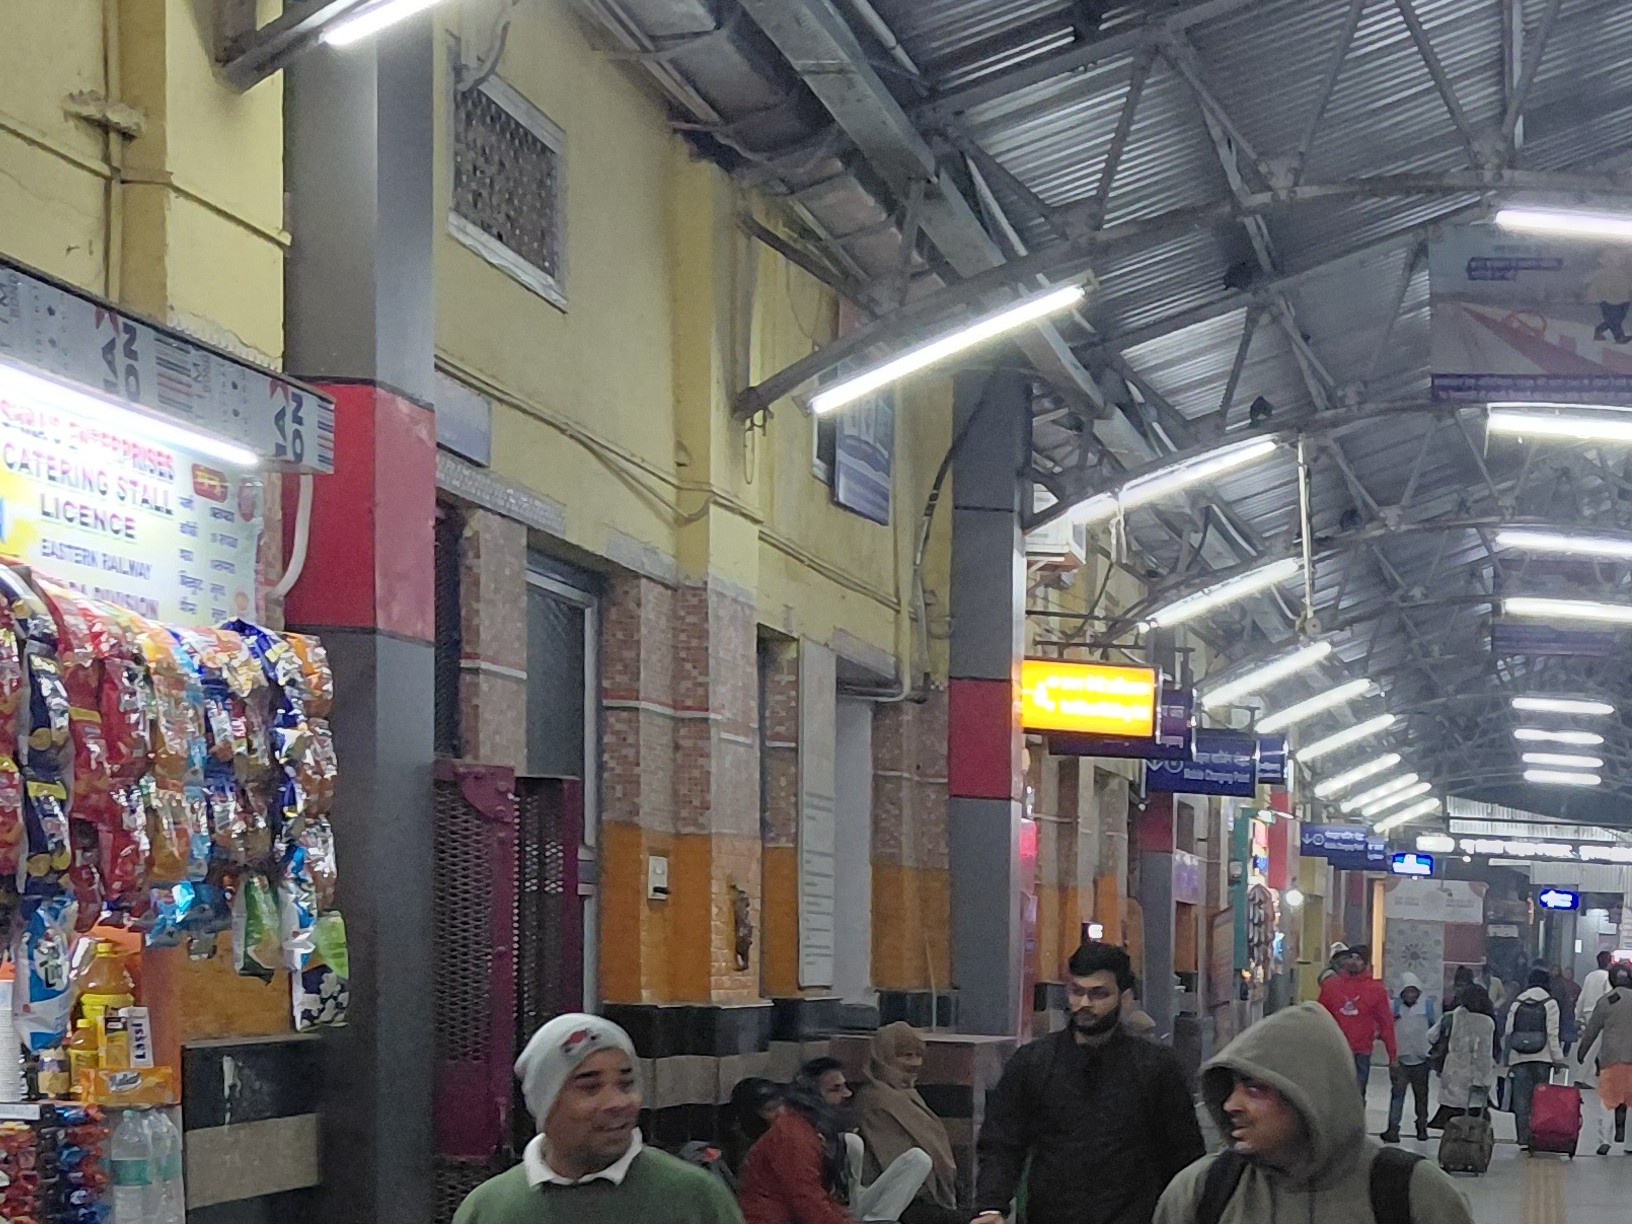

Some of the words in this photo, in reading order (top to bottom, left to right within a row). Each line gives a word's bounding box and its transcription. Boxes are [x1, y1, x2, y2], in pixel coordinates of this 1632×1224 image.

[3, 442, 109, 497] CATERING
[115, 475, 174, 516] STALL
[40, 492, 137, 540] LICENCE
